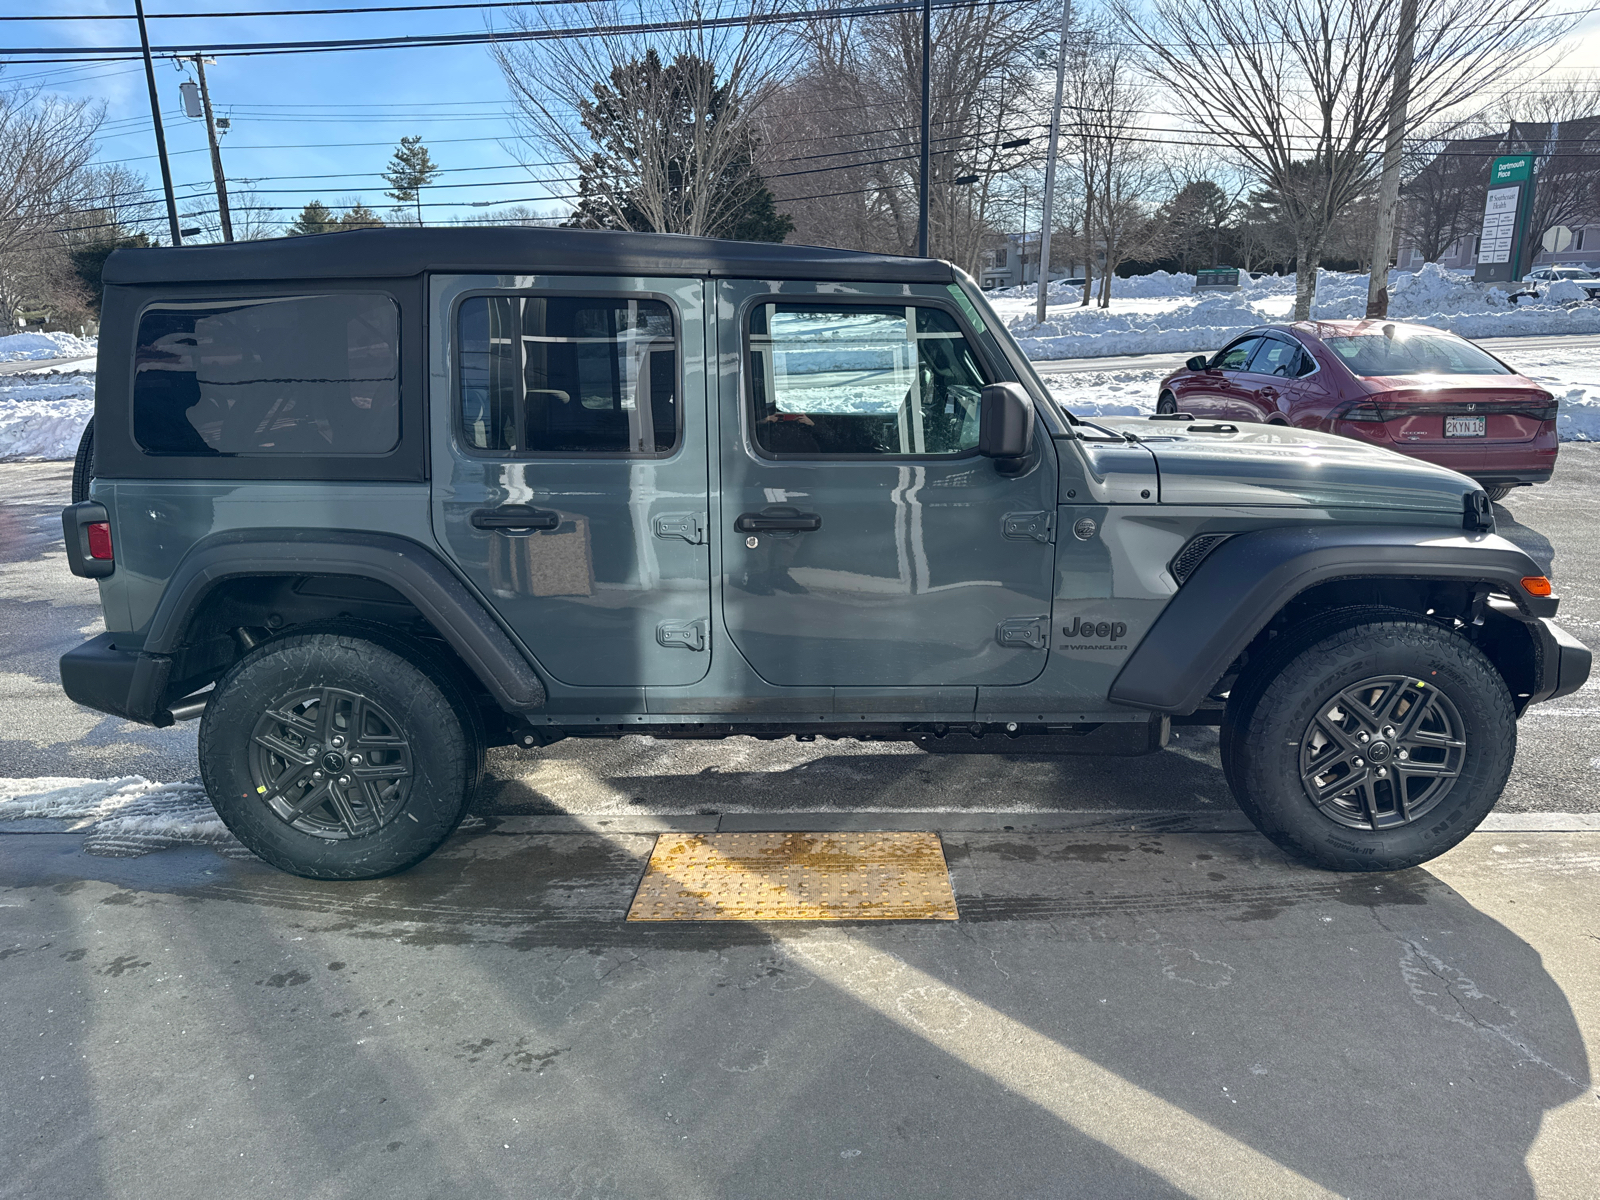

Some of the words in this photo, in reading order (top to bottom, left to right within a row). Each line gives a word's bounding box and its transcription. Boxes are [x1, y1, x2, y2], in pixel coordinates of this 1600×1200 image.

[1498, 160, 1525, 171] Dartmouth
[1493, 201, 1507, 210] Health
[1446, 421, 1470, 433] 2KYN
[1472, 421, 1484, 433] 18
[1062, 616, 1128, 642] Jeep
[1325, 838, 1376, 855] All-Weather
